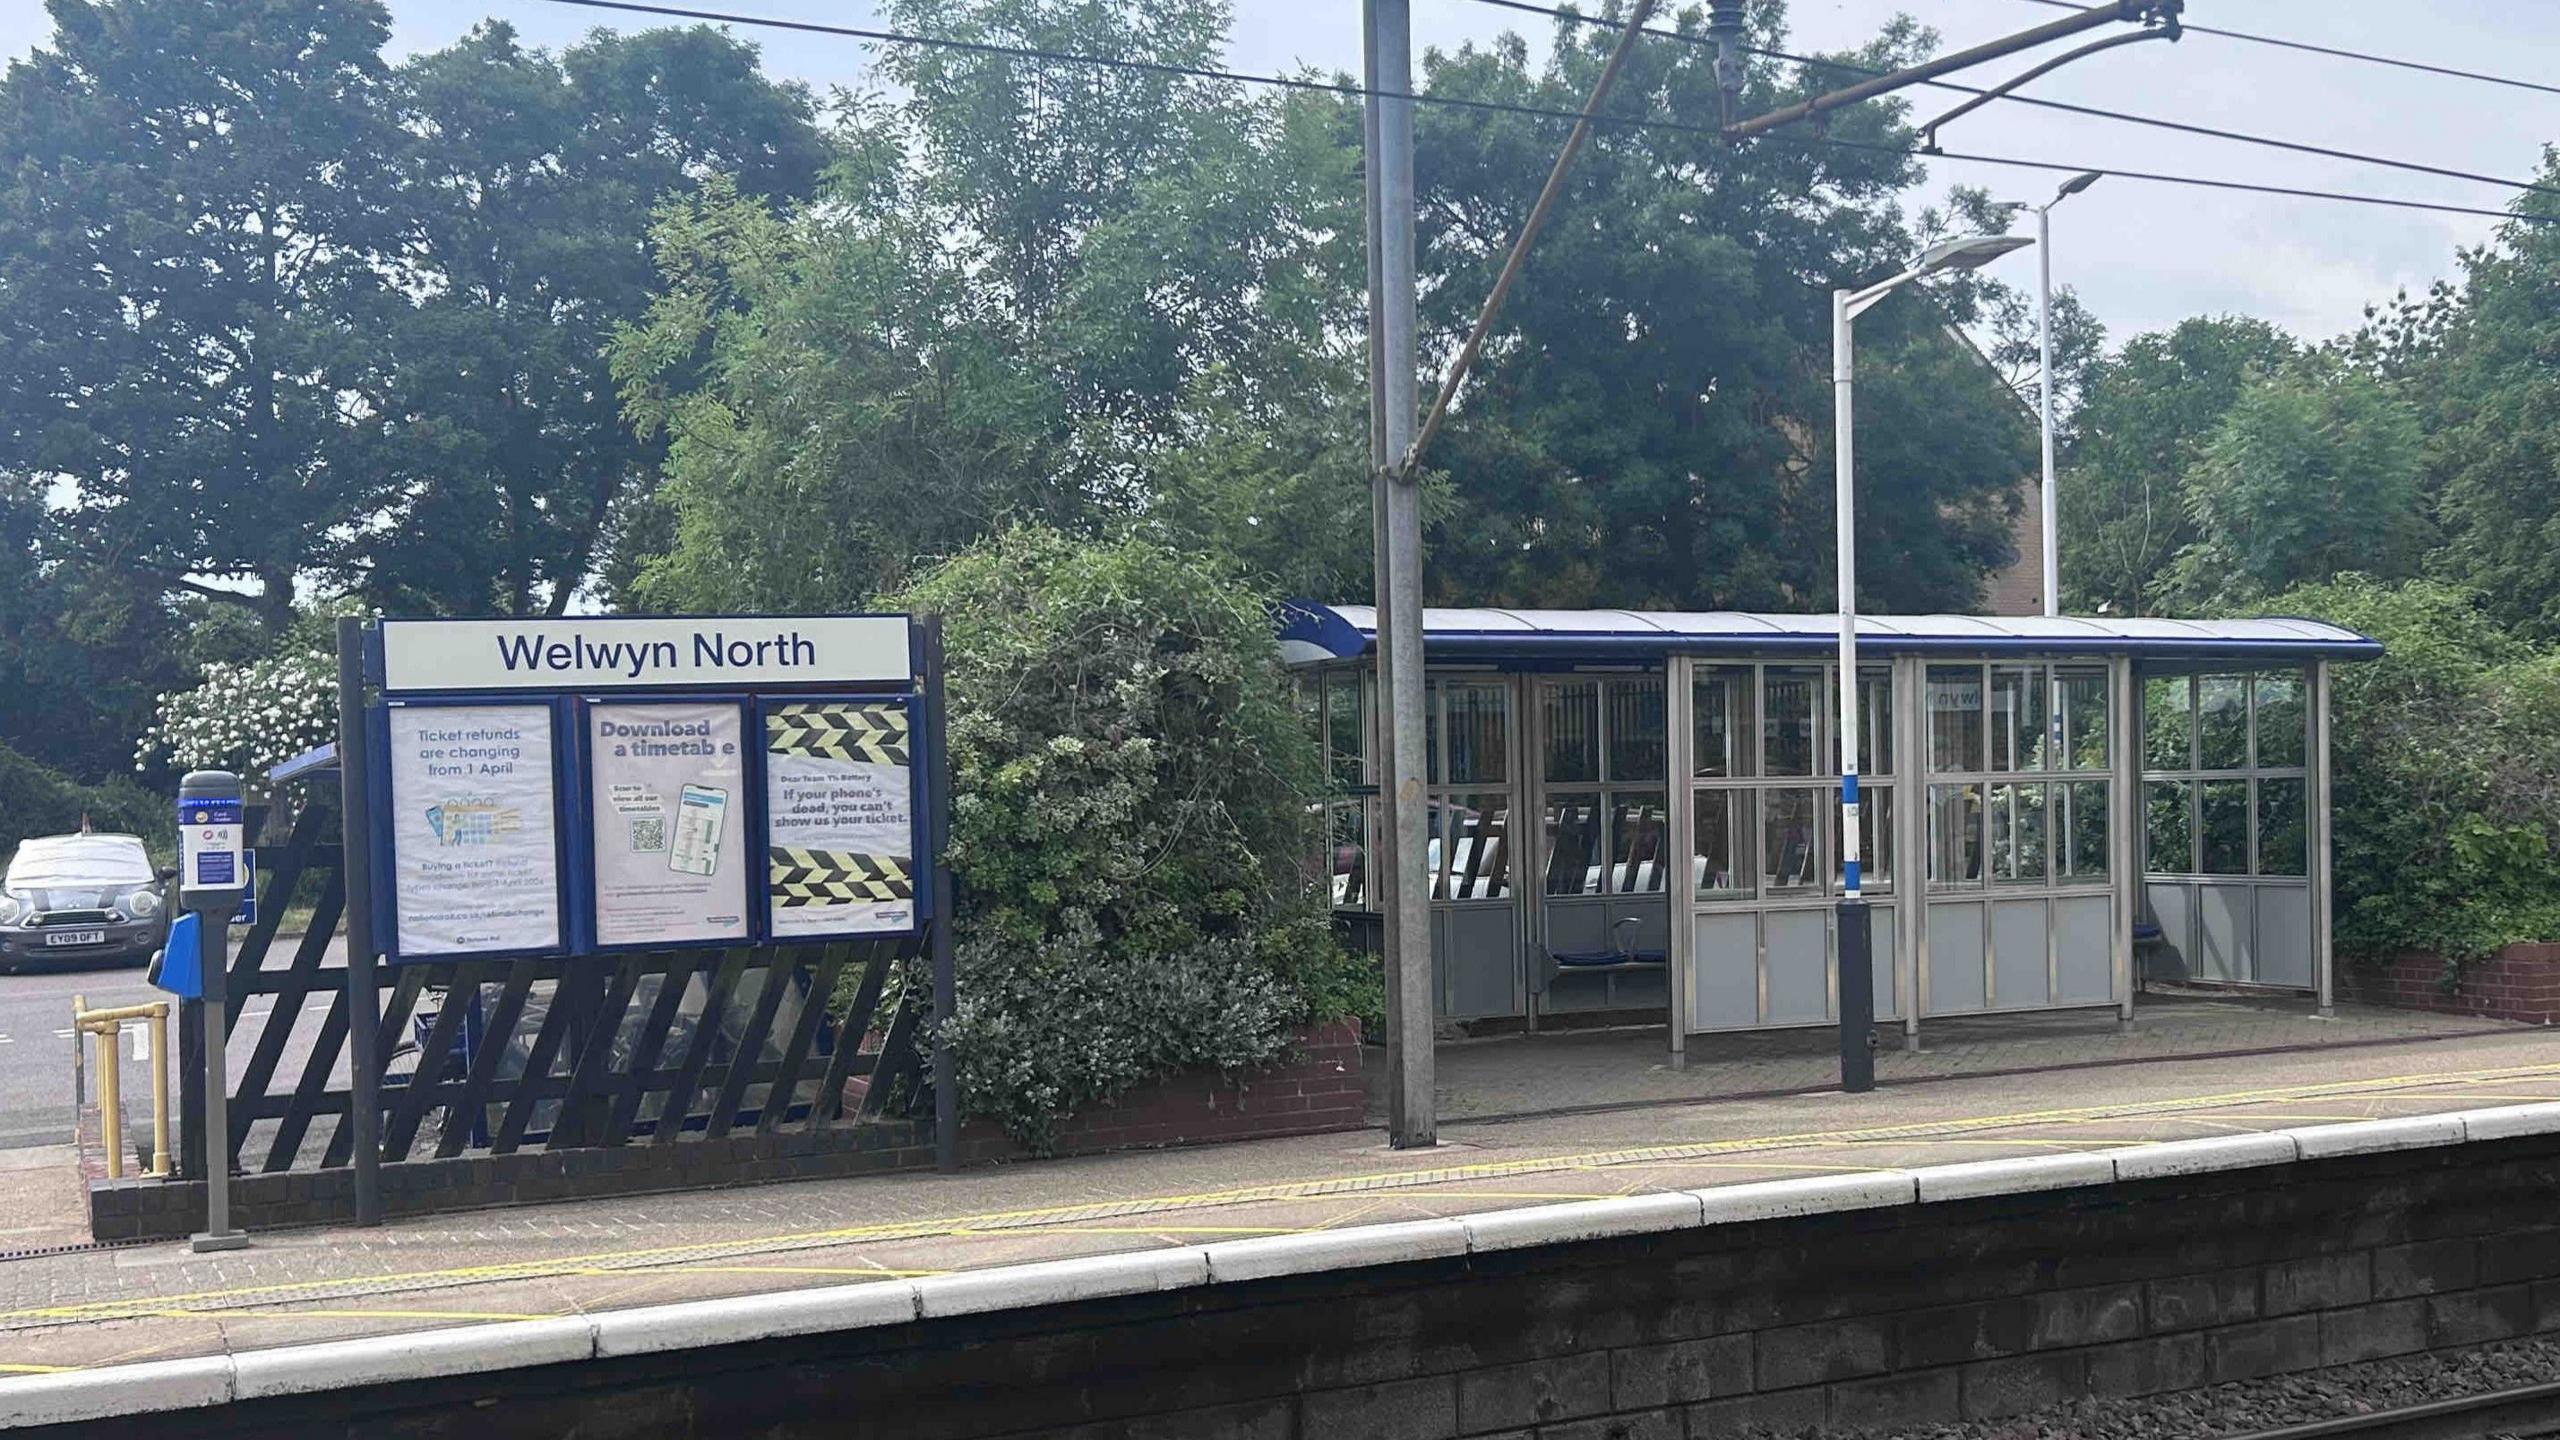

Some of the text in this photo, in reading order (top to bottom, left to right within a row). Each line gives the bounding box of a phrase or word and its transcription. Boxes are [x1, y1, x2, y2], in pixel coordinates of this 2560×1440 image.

[496, 632, 815, 678] Welwyn North
[418, 728, 521, 742] Ticket refunds
[600, 719, 711, 738] Download
[420, 746, 521, 760] are changing
[614, 744, 626, 757] a
[428, 762, 513, 776] from 1 April
[783, 787, 881, 802] If your phone's
[792, 801, 893, 815] dead, you can't
[775, 813, 908, 828] show us your ticket.
[50, 933, 78, 943] EY09
